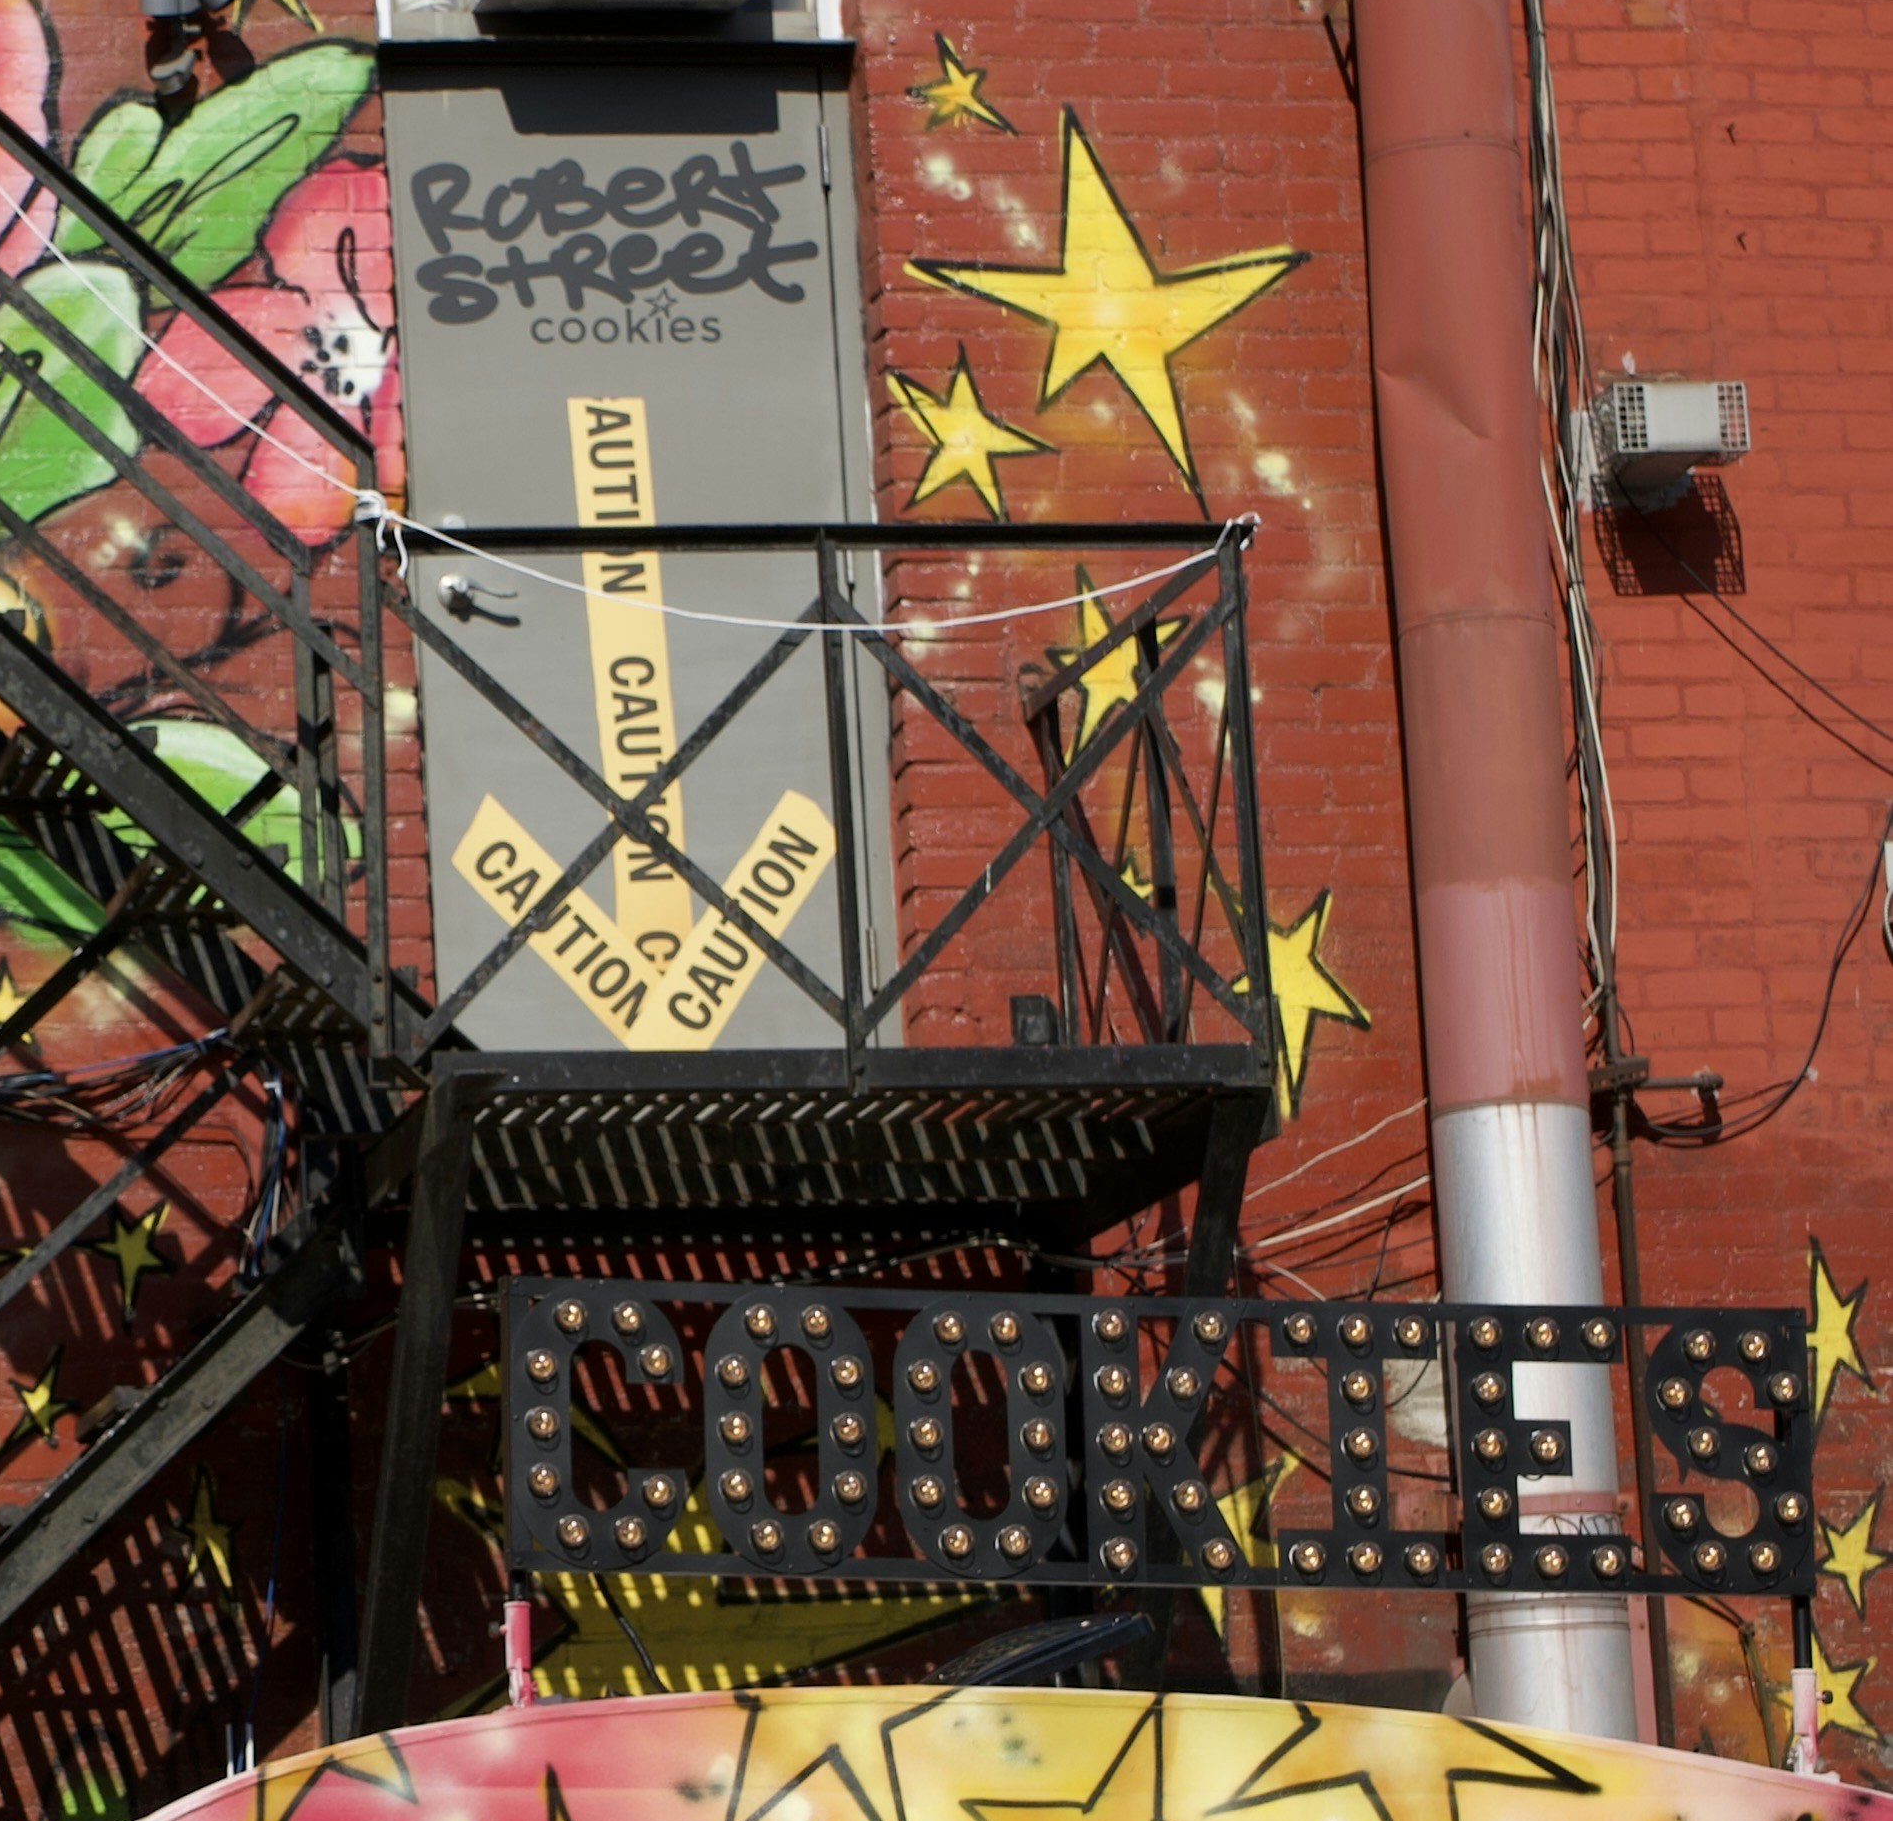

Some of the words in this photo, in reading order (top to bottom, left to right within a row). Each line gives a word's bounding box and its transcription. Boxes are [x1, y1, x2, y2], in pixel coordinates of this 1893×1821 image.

[530, 303, 722, 345] cookies
[609, 656, 674, 882] CAUTN
[668, 825, 819, 1030] CAUION
[510, 1284, 1814, 1591] COOKIES
